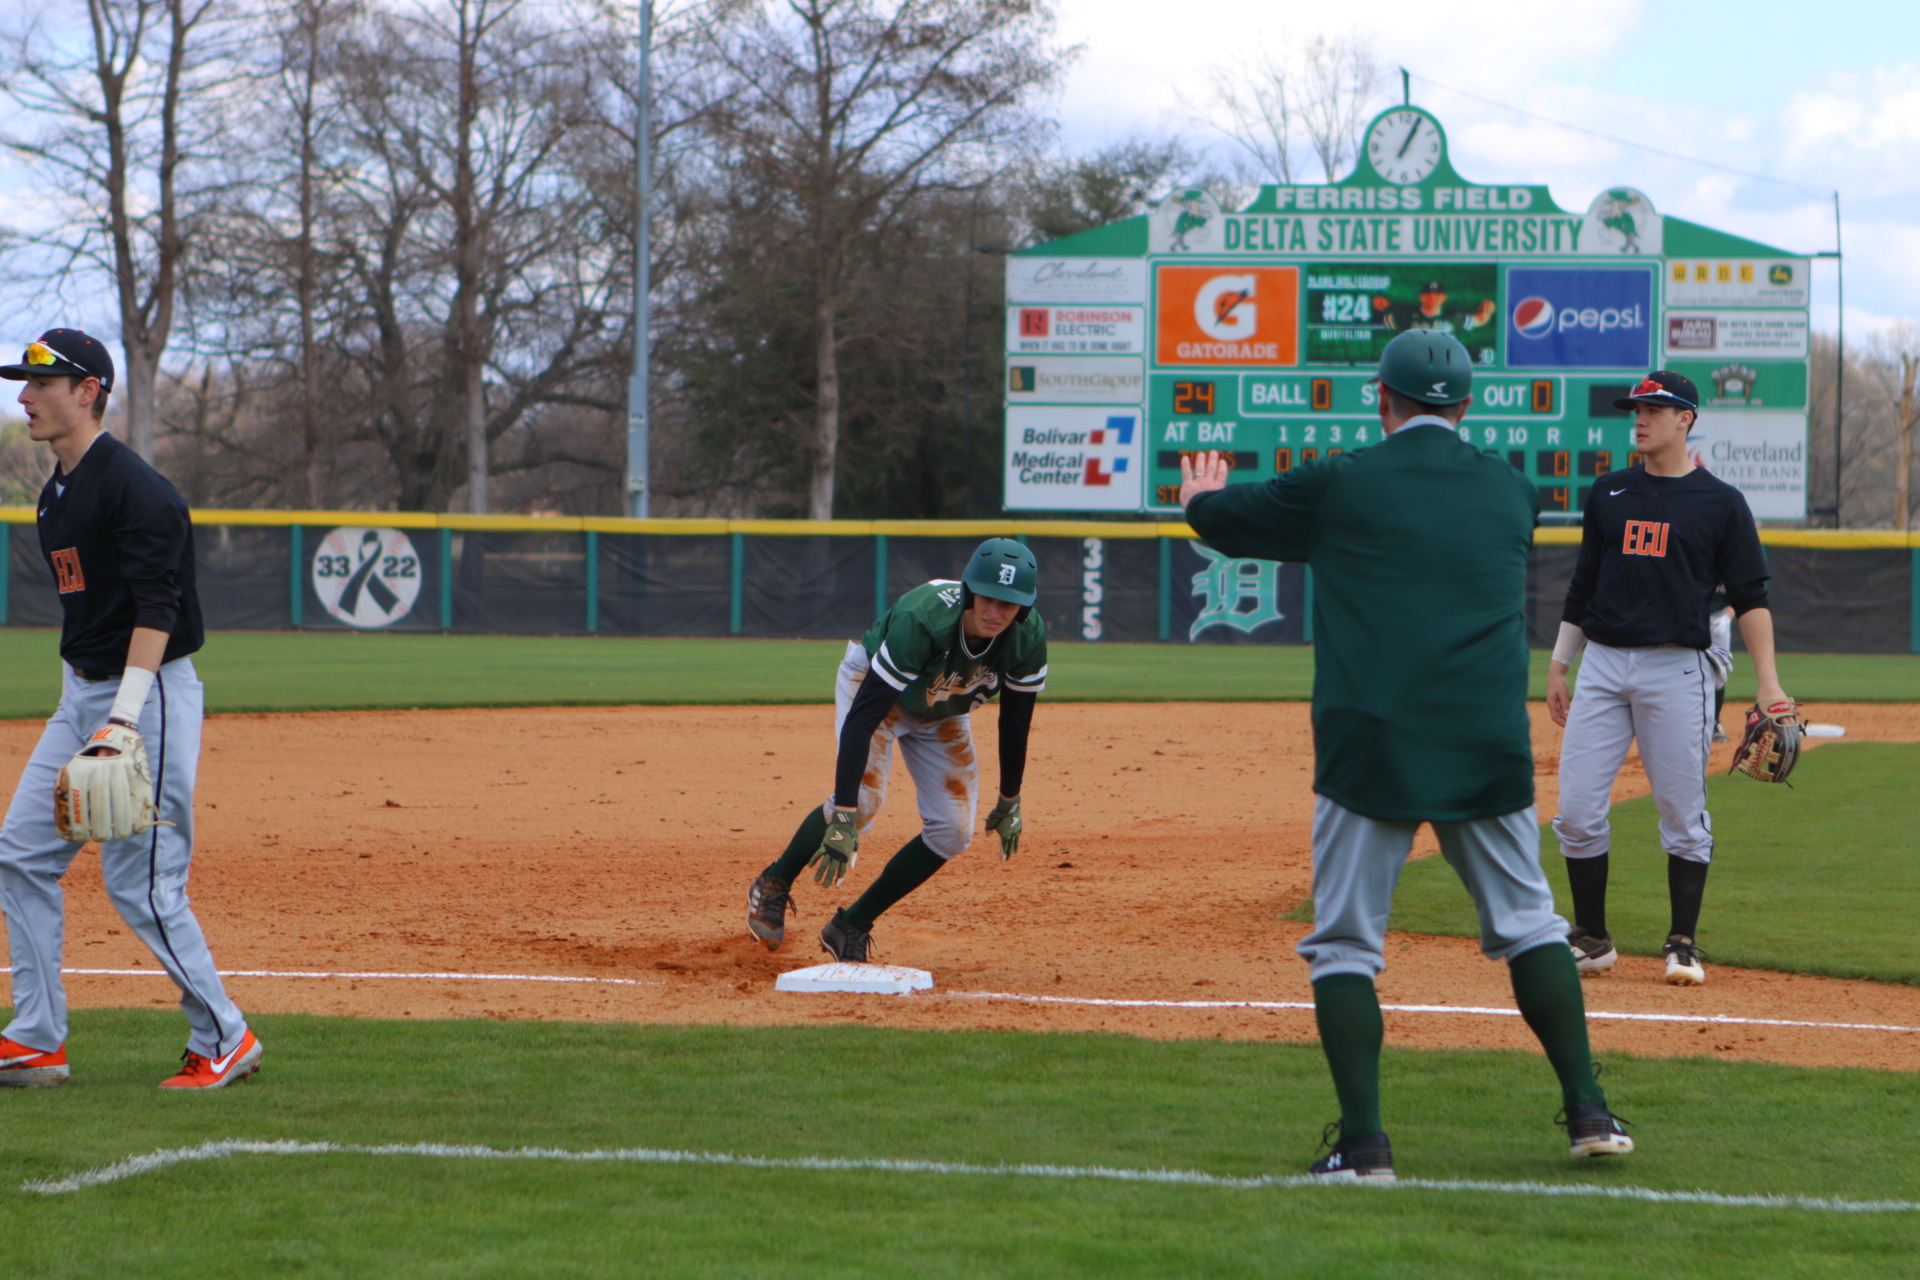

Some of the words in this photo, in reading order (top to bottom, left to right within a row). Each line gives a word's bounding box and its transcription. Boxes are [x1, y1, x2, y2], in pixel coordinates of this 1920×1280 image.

[1276, 187, 1422, 209] FERRISS
[1434, 188, 1532, 210] FIELD
[1225, 217, 1306, 251] DELTA
[1317, 217, 1401, 251] STATE
[1413, 217, 1584, 252] UNIVERSITY
[1033, 260, 1123, 282] Cleveland
[1056, 312, 1132, 323] ROBINSON
[1194, 274, 1257, 341] G
[1322, 295, 1370, 321] #24
[1559, 303, 1641, 333] pepsi
[1682, 320, 1712, 330] FARM
[1764, 321, 1785, 329] HOME
[1787, 321, 1806, 329] TEAM
[1055, 324, 1117, 336] ELECTRIC
[1671, 329, 1712, 338] BUREAU
[1020, 342, 1040, 351] WHEN
[1042, 342, 1049, 350] IT
[1051, 342, 1065, 350] HAS
[1068, 342, 1077, 350] TO
[1111, 342, 1132, 351] RIGHT
[1176, 342, 1279, 359] GATORADE
[1174, 382, 1214, 413] 24
[1252, 384, 1306, 404] BALL
[1313, 379, 1331, 410] 0
[1483, 386, 1527, 406] OUT
[1532, 380, 1552, 412] 0
[1023, 428, 1087, 444] Bolivar
[1164, 422, 1189, 441] AT
[1198, 422, 1237, 442] BAT
[1279, 425, 1288, 442] 1
[1304, 426, 1315, 442] 2
[1330, 426, 1341, 442] 3
[1355, 426, 1367, 442] 4
[1484, 428, 1496, 444] 9
[1507, 428, 1527, 444] 10
[1547, 428, 1560, 444] R
[1588, 429, 1602, 445] H
[1011, 452, 1084, 468] Medical
[1711, 440, 1802, 462] Cleveland
[1020, 468, 1081, 484] Center
[1711, 465, 1756, 478] STATE
[1760, 466, 1802, 479] BANK
[1739, 482, 1766, 491] future
[1768, 482, 1787, 491] with
[1554, 487, 1569, 510] 4
[1622, 519, 1670, 557] ECU
[51, 546, 86, 594] ECU
[317, 555, 350, 578] 33
[383, 555, 417, 578] 22
[71, 788, 82, 825] marucci
